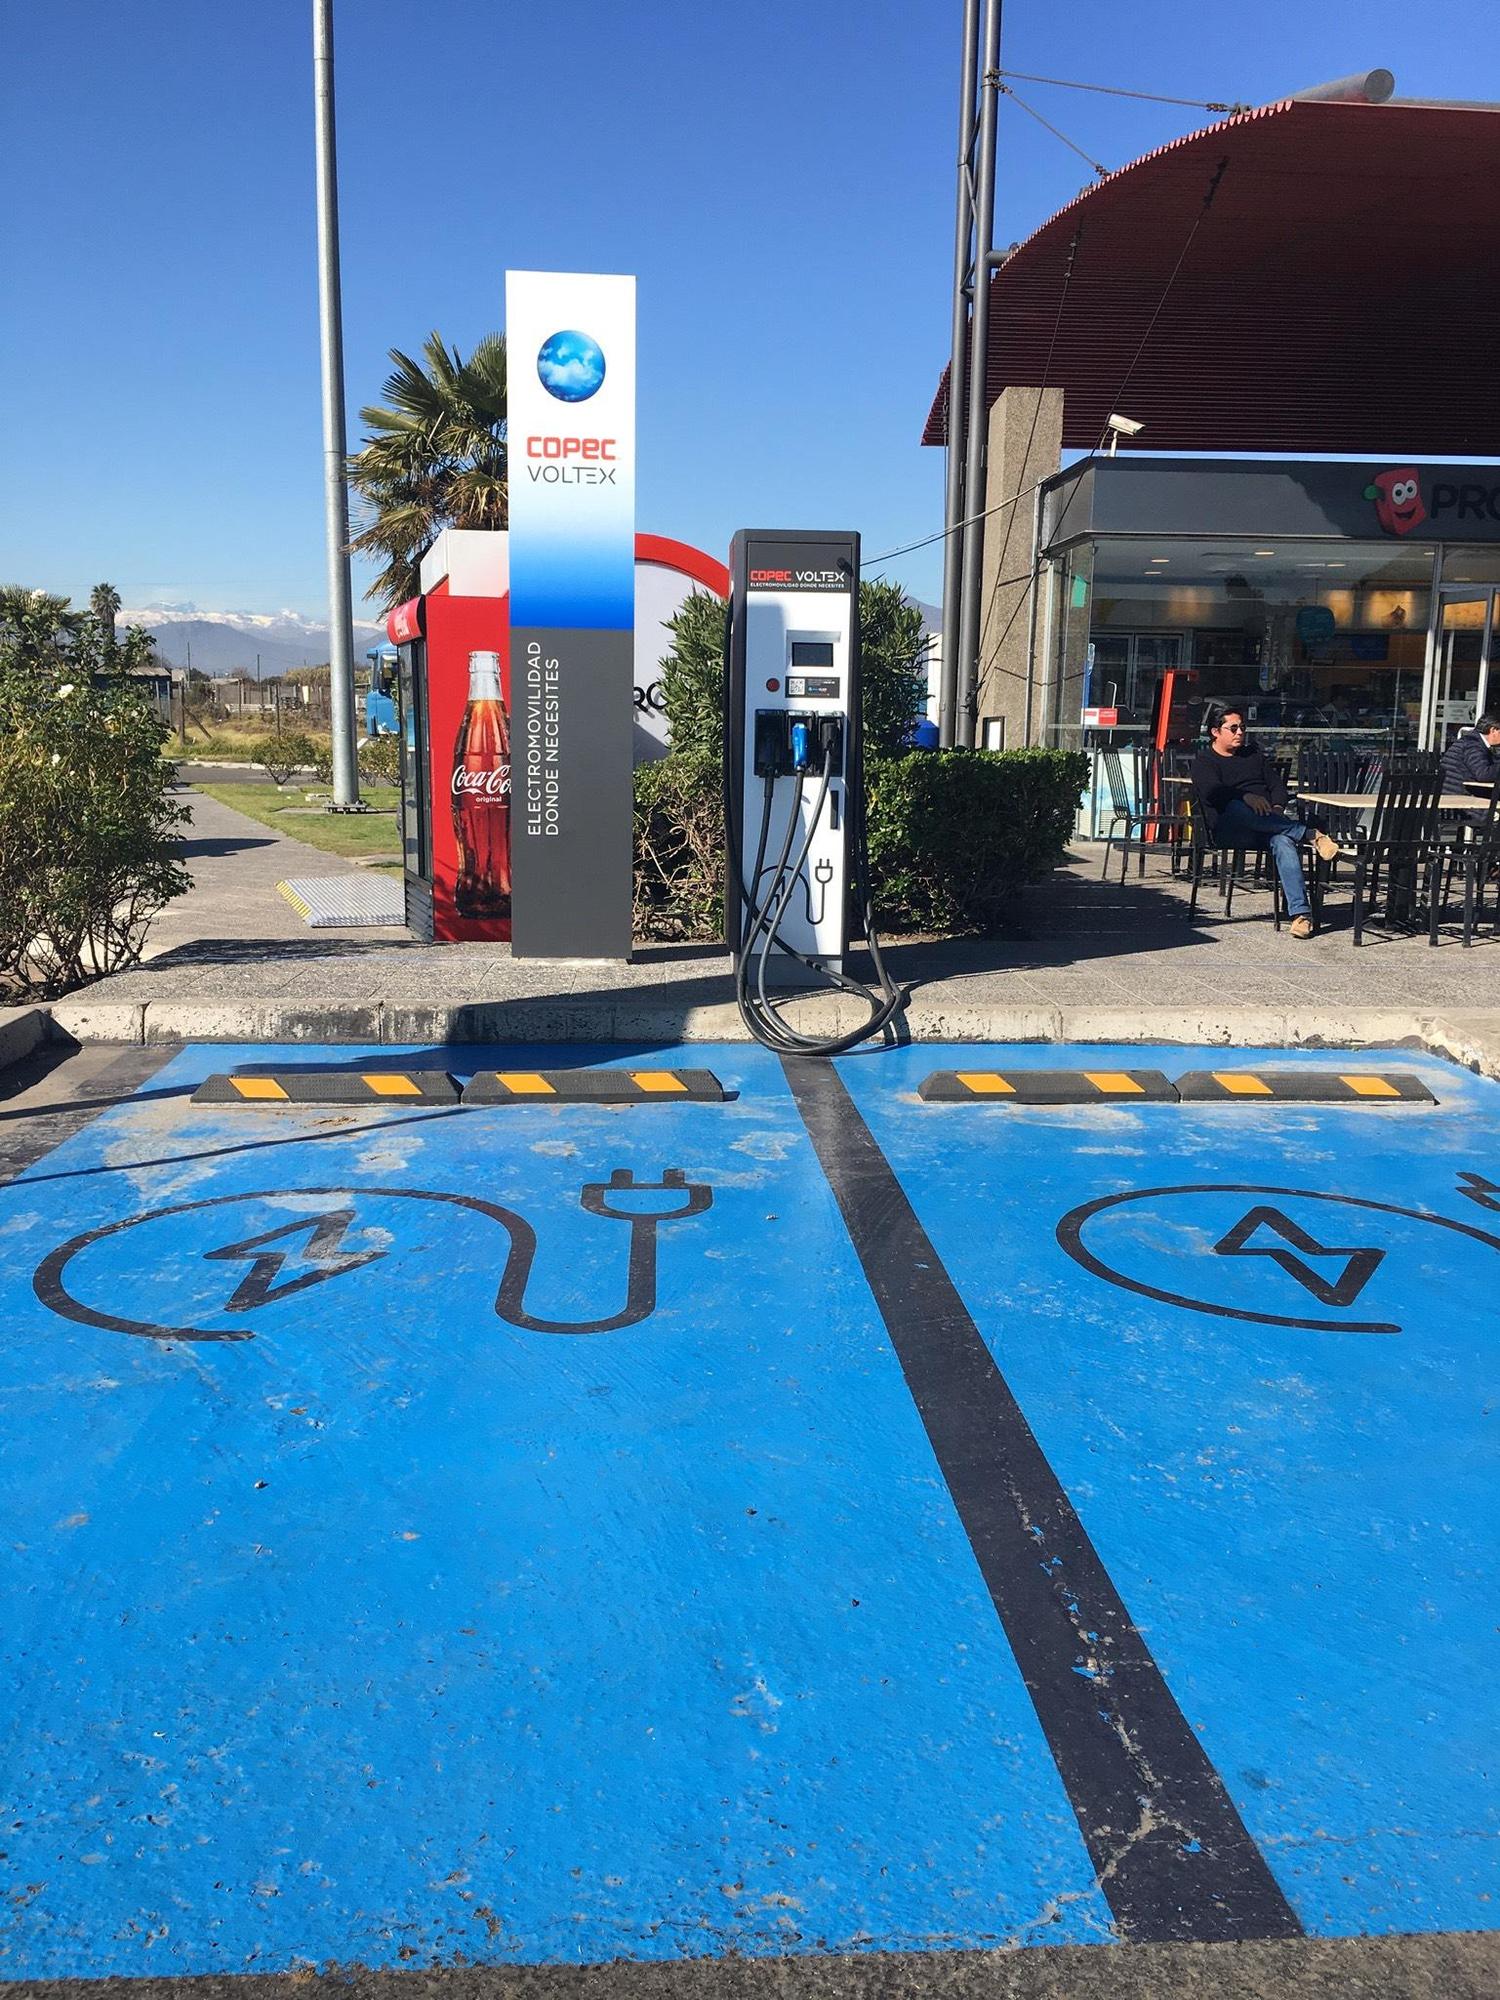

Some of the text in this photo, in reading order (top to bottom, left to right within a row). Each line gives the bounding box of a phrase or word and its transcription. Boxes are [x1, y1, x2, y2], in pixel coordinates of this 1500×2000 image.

[526, 436, 617, 460] COPEC
[527, 465, 616, 485] VOLTEX
[750, 570, 845, 582] COPEC VOLTEX
[527, 642, 542, 836] ELECTROMOVILIDAD
[545, 658, 559, 836] DONDE NECESITES
[451, 764, 512, 795] Coca-Co
